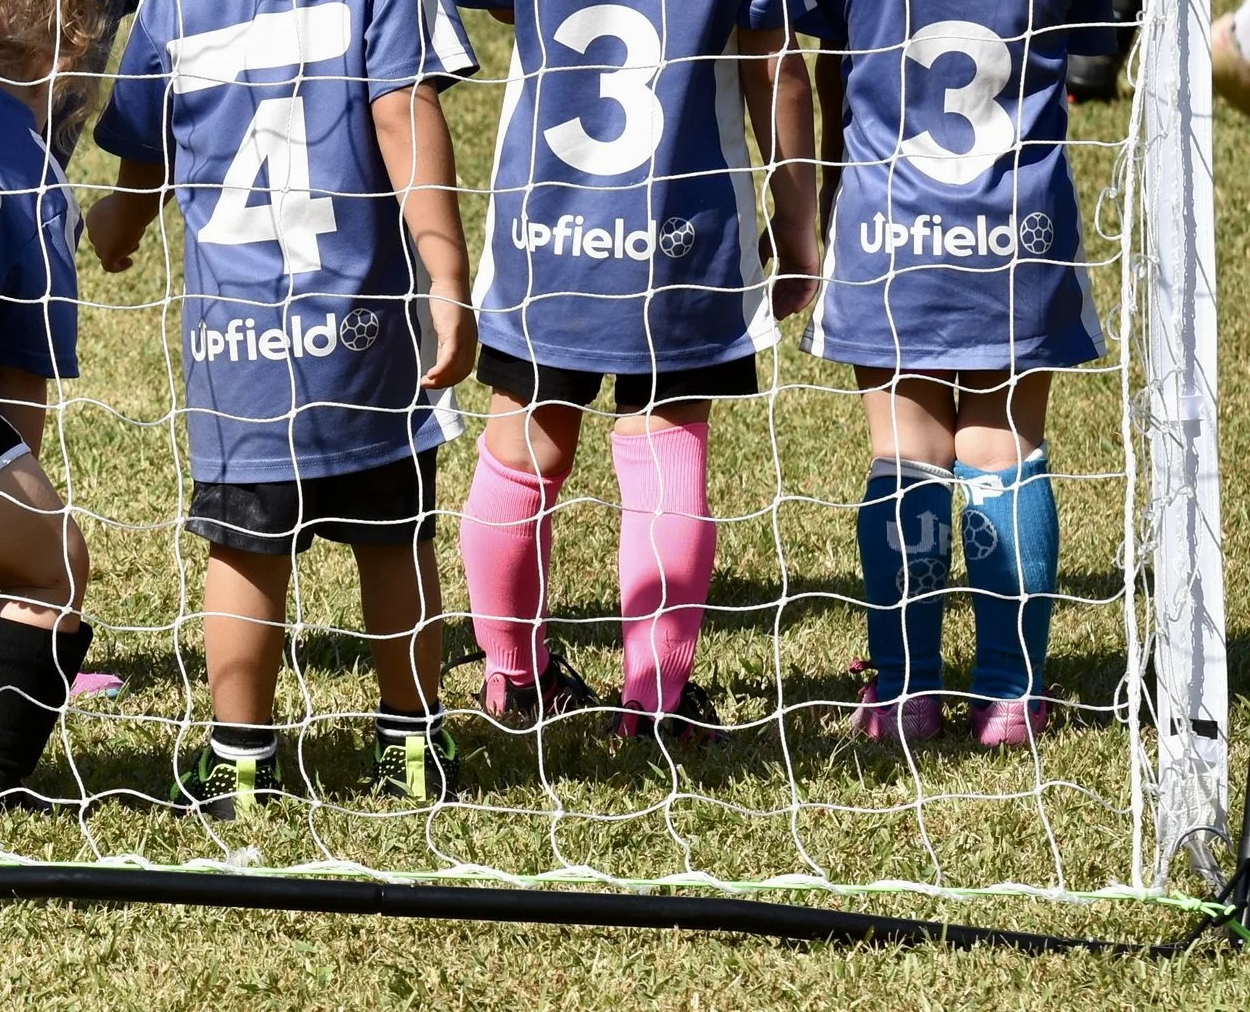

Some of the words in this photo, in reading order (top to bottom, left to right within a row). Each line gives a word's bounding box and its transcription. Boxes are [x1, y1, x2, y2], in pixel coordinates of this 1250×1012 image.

[544, 4, 664, 176] 3
[900, 20, 1014, 185] 3
[198, 96, 337, 275] 4
